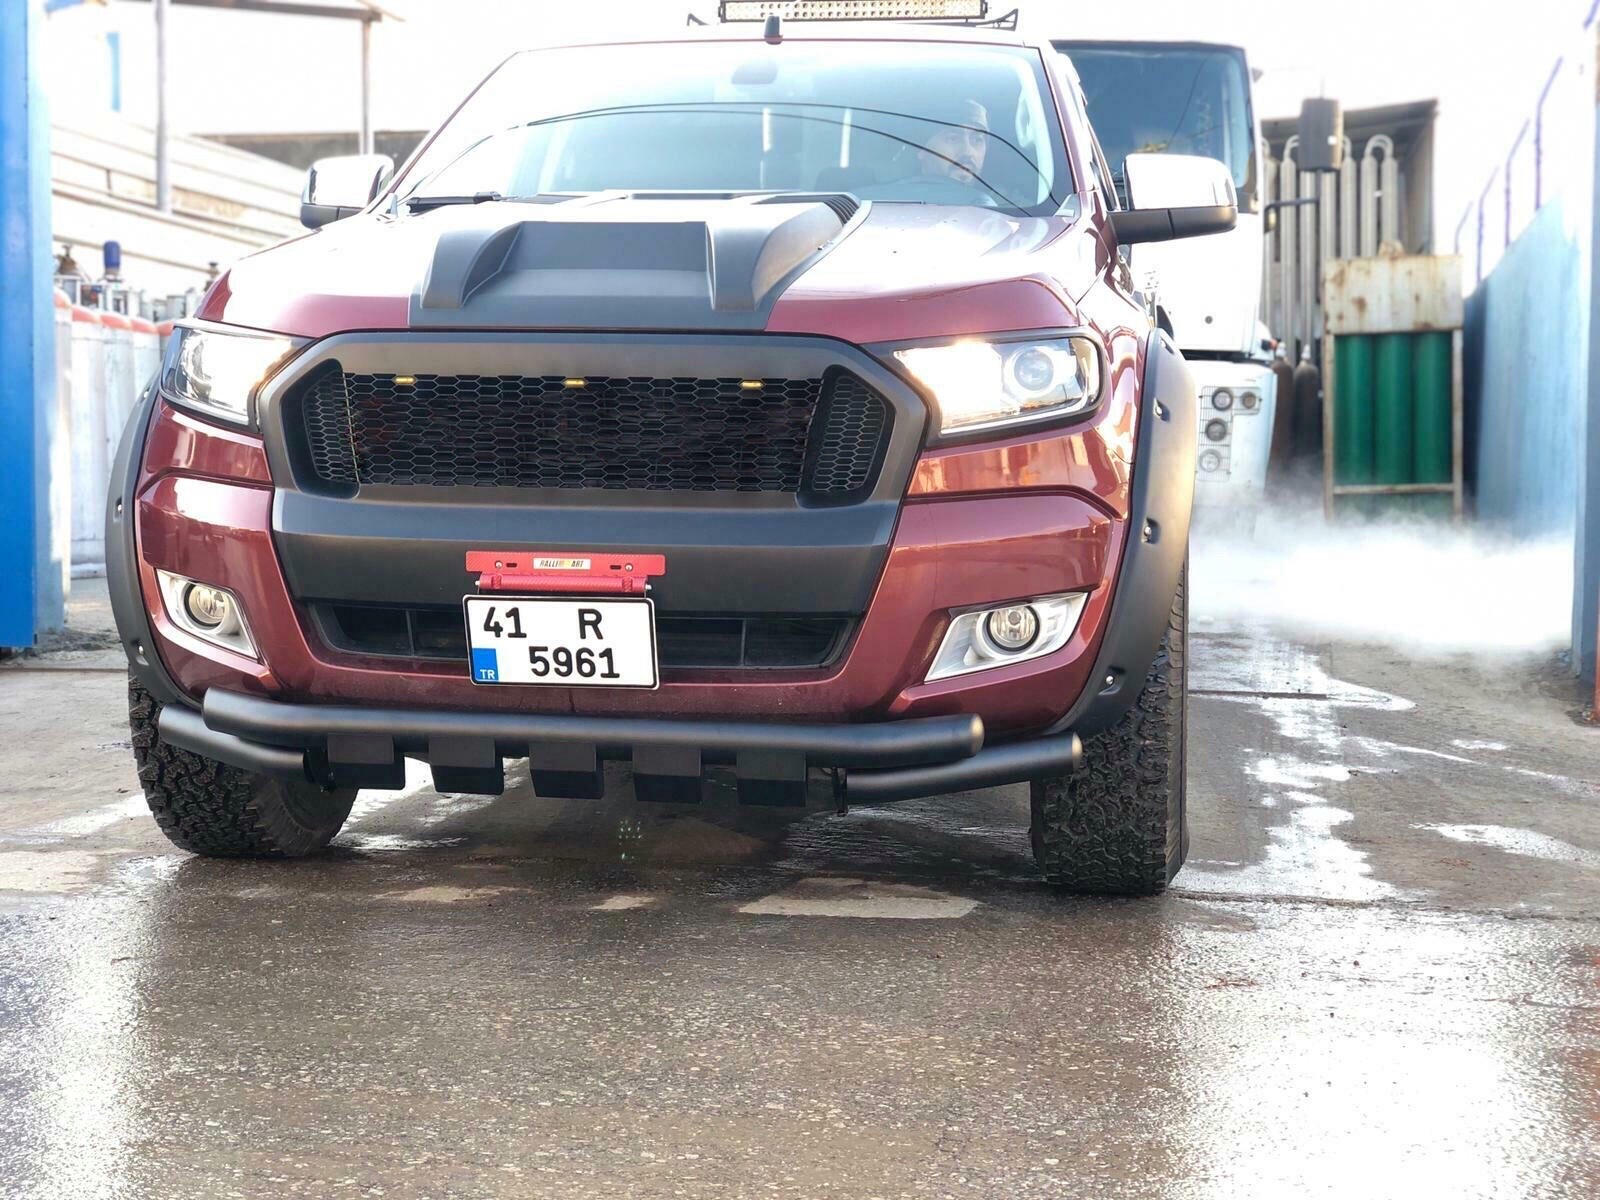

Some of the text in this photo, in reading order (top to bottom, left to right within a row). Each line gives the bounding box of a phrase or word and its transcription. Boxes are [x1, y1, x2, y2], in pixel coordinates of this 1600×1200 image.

[483, 607, 604, 640] 41 R
[480, 669, 495, 679] TR
[528, 646, 620, 679] 5961
